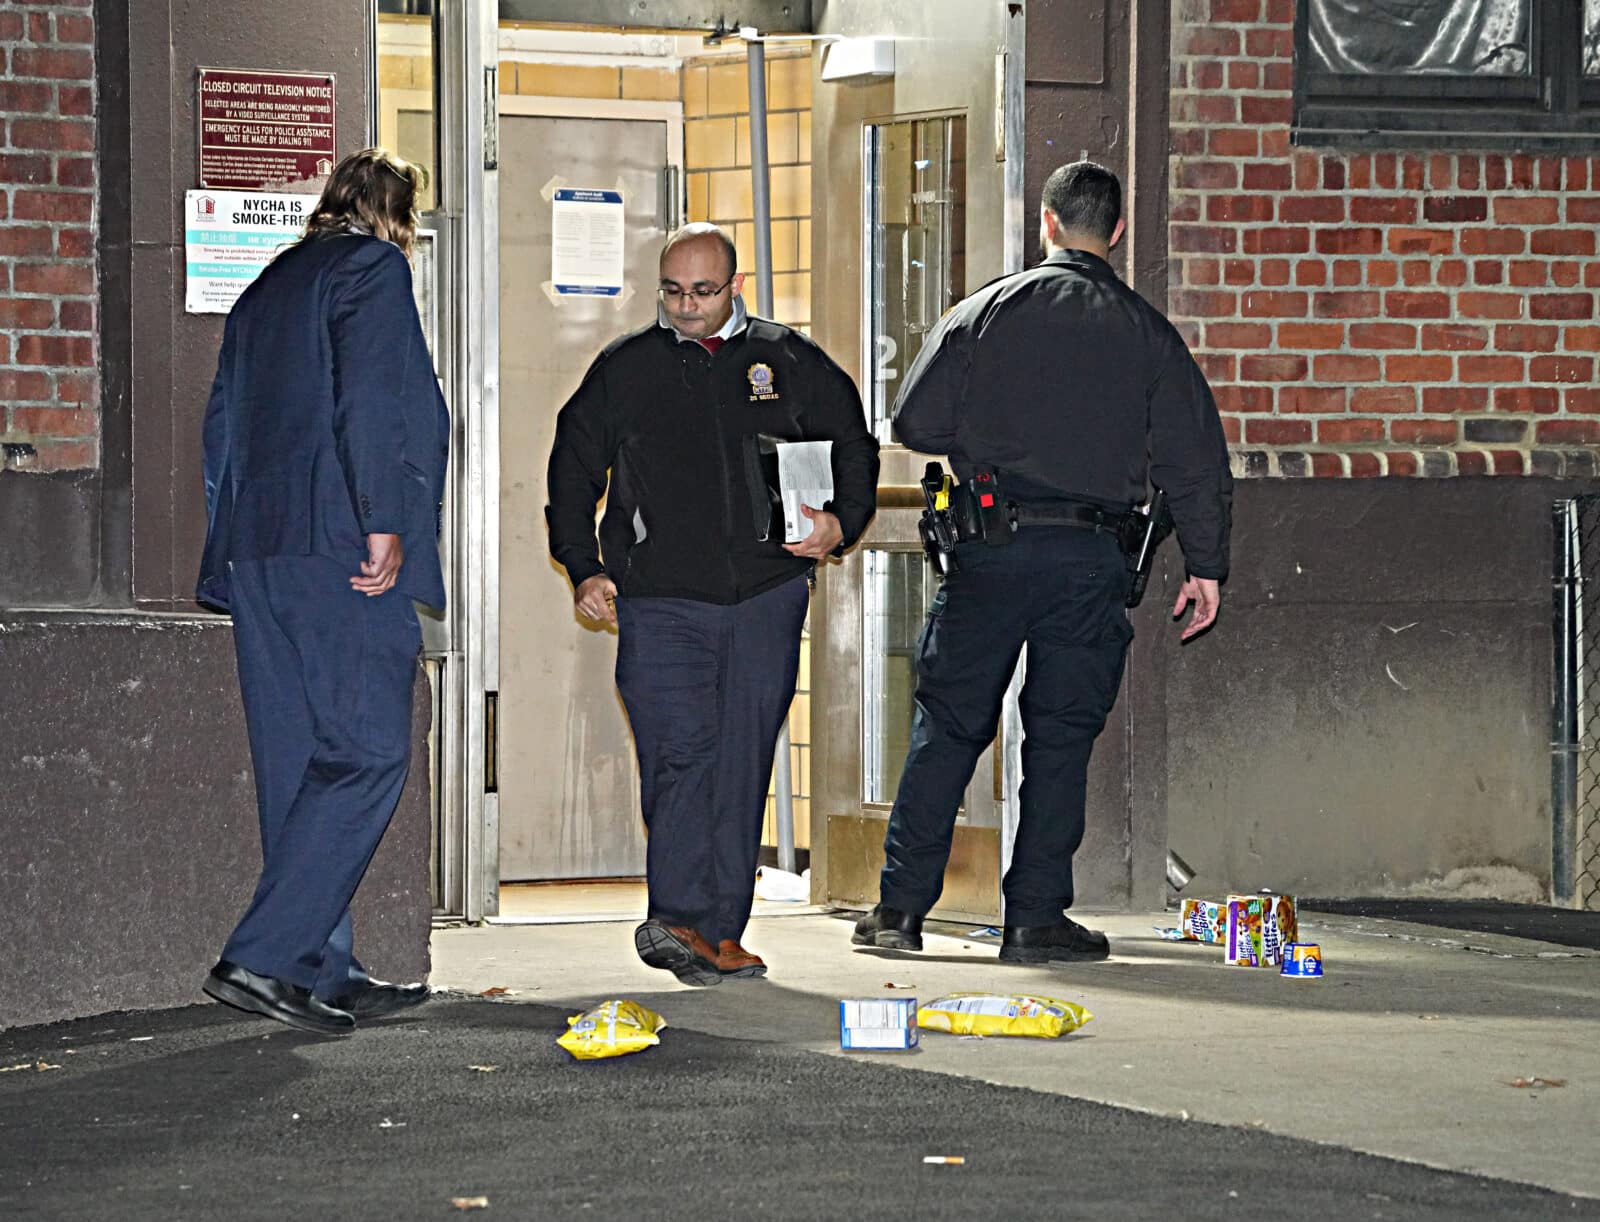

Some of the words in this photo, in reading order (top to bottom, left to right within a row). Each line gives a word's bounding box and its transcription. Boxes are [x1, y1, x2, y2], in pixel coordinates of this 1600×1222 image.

[204, 81, 231, 93] CLOSED
[233, 83, 261, 94] CIRCUIT
[263, 84, 304, 97] TELEVISION
[306, 86, 332, 98] NOTICE
[205, 100, 229, 108] SELECTED
[230, 101, 246, 109] AREAS
[248, 102, 257, 110] ARE
[258, 102, 273, 111] BEING
[275, 103, 301, 111] RANDOMLY
[302, 104, 330, 113] MONITORED
[226, 110, 232, 118] BY
[238, 111, 253, 119] VIDEO
[254, 112, 290, 120] SURVEILLANCE
[291, 113, 310, 121] SYSTEM
[205, 123, 240, 134] EMERGENCY
[242, 125, 260, 135] CALLS
[261, 126, 273, 135] FOR
[274, 127, 295, 136] POLICE
[296, 128, 330, 138] ASSISTANCE
[224, 134, 240, 143] MUST
[242, 135, 250, 143] BE
[251, 135, 268, 144] MADE
[269, 136, 277, 144] BY
[278, 136, 301, 146] DIALING
[303, 137, 312, 146] 911
[243, 199, 285, 212] NYCHA
[290, 201, 302, 213] IS
[232, 212, 305, 226] SMOKE-FRE
[1199, 902, 1209, 928] Bites
[1189, 911, 1203, 935] Little
[1271, 913, 1279, 946] Bites
[1263, 926, 1274, 958] Little
